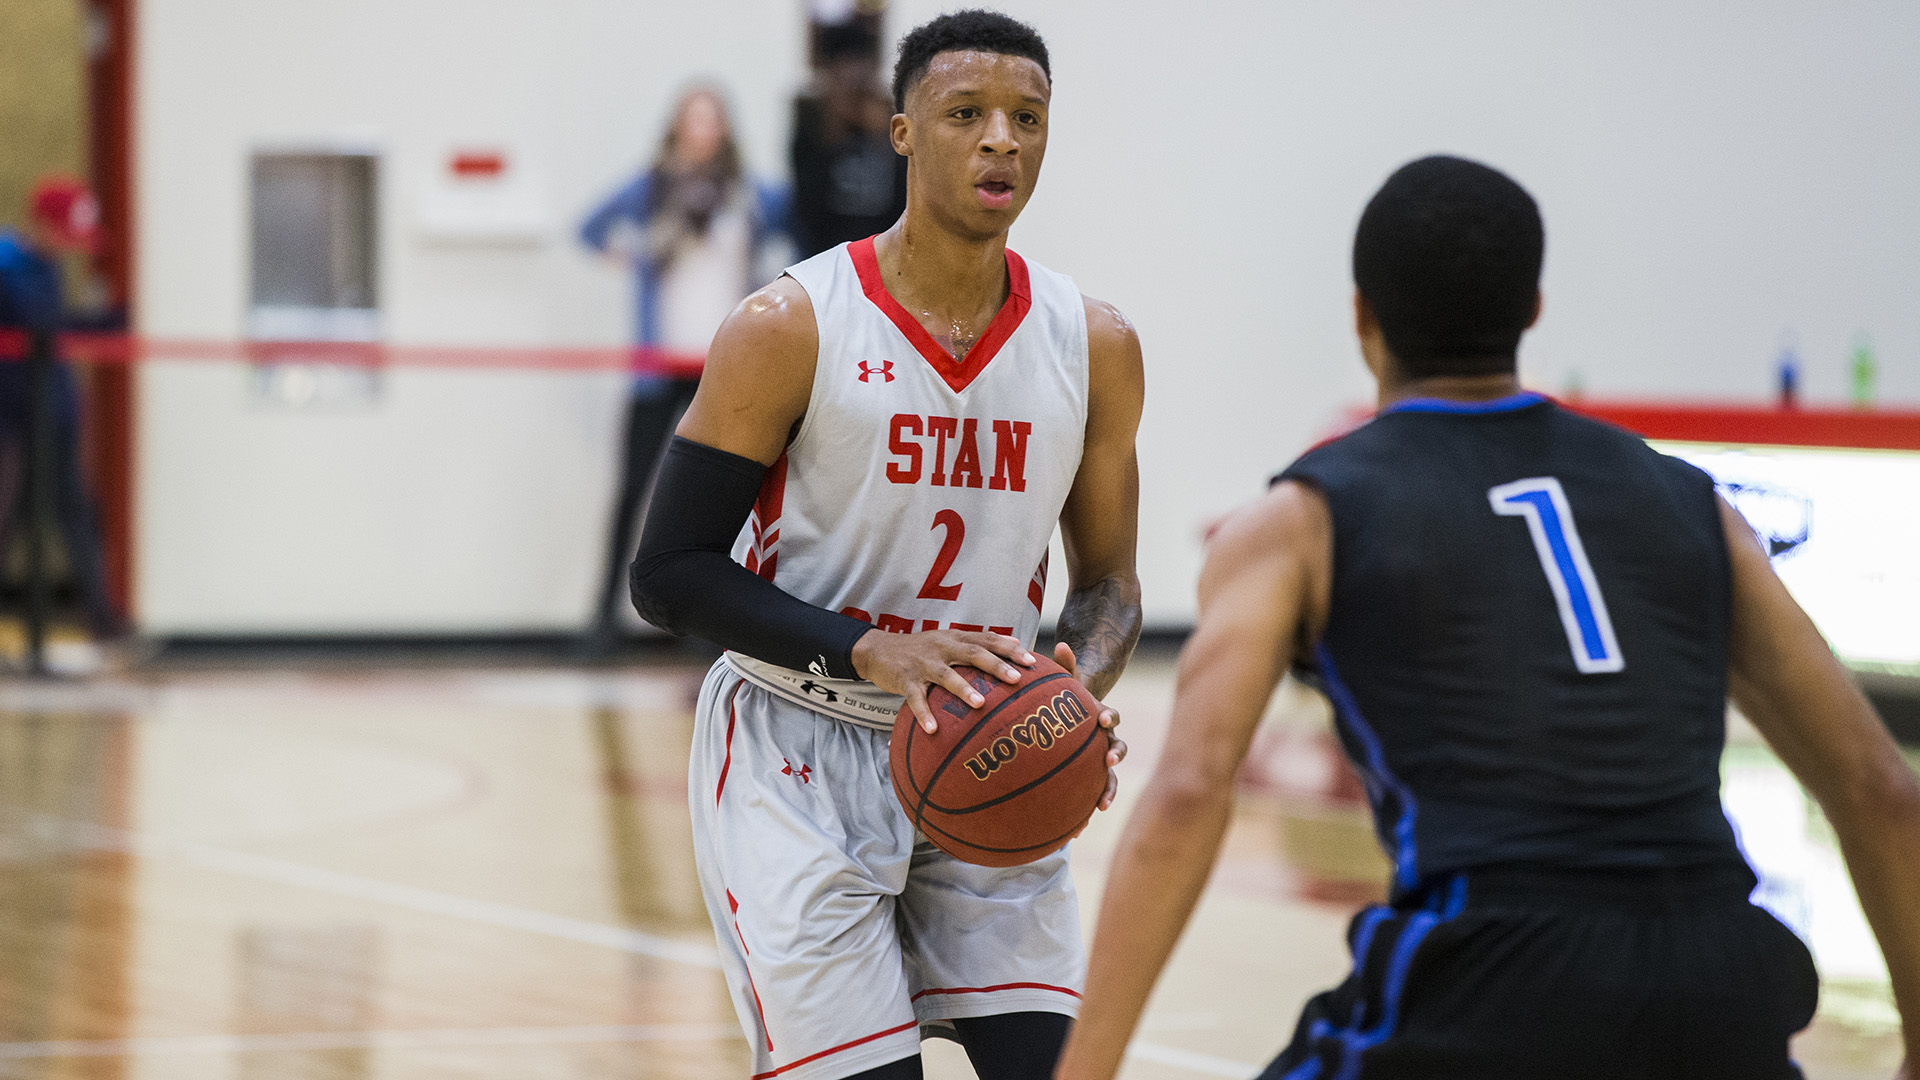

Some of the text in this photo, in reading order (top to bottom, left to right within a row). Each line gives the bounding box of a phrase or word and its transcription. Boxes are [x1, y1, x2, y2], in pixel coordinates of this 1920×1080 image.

[886, 413, 1032, 492] STAN
[916, 509, 966, 601] 2
[1488, 476, 1625, 673] 1
[963, 689, 1091, 781] Wilson
